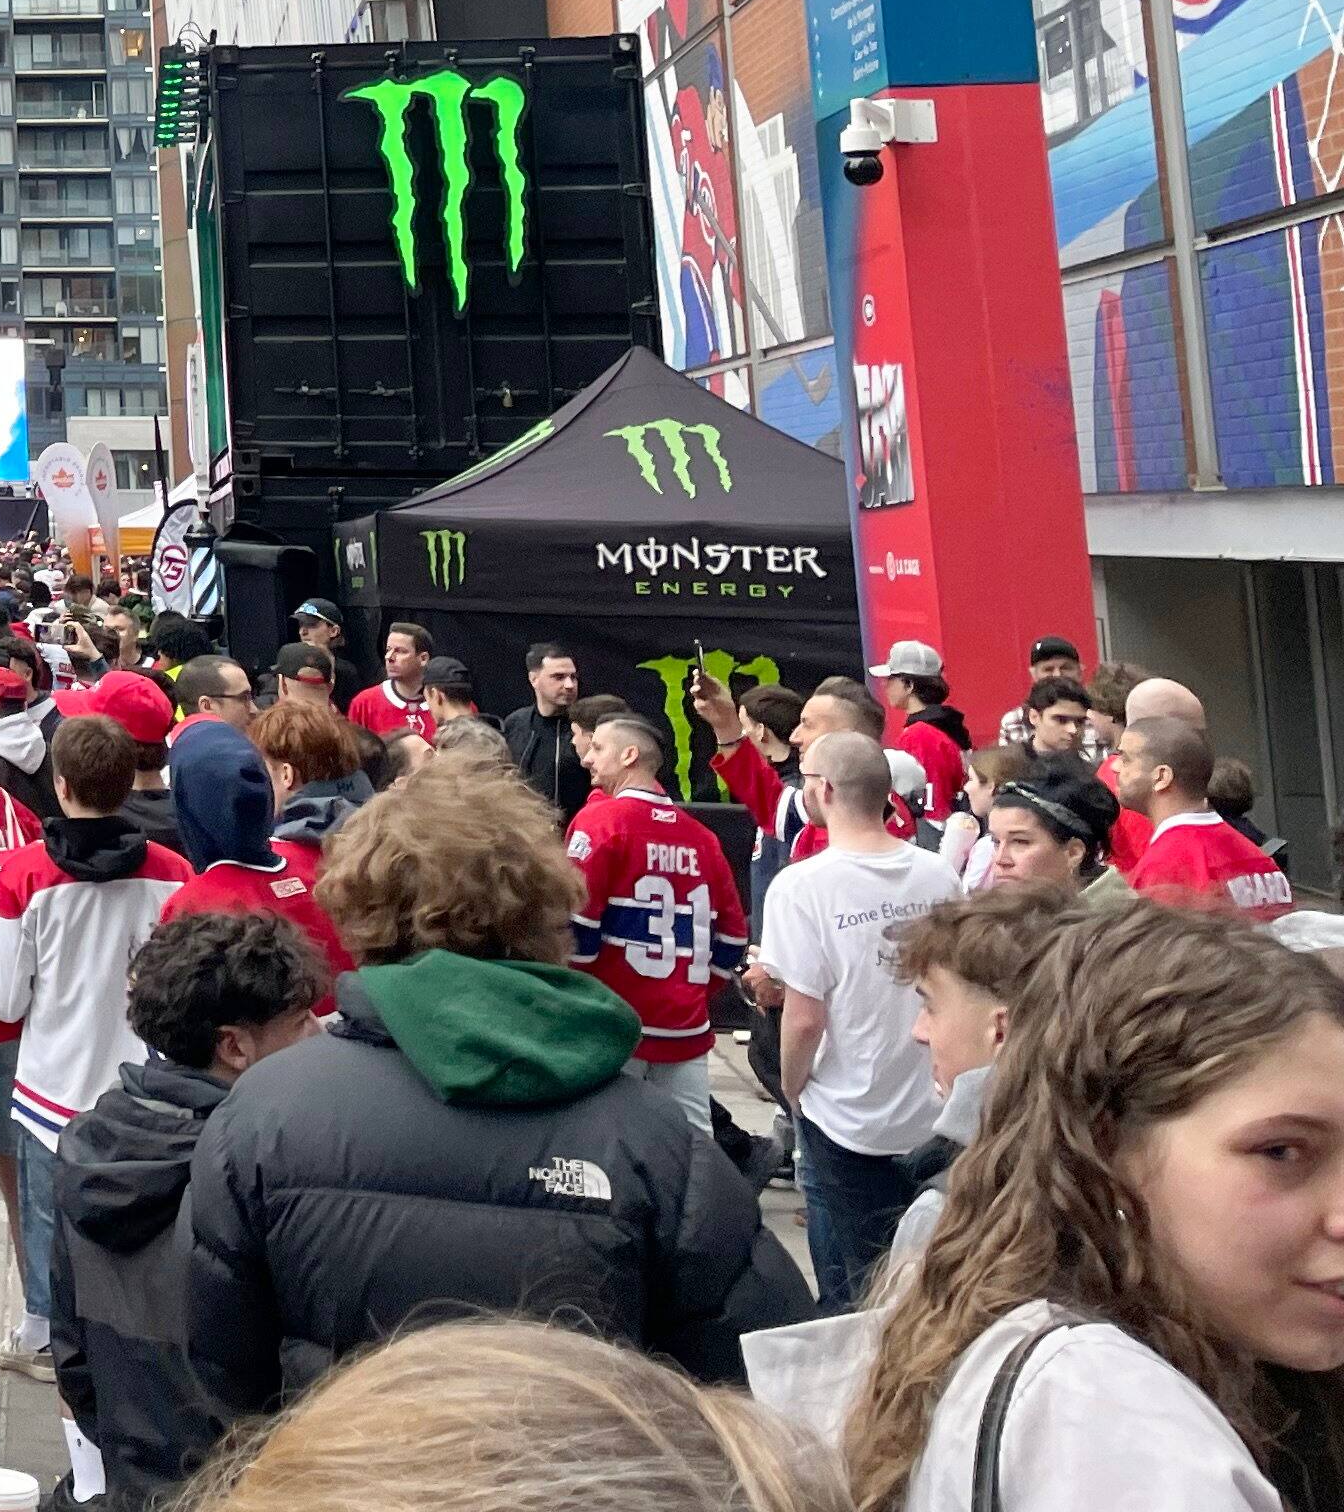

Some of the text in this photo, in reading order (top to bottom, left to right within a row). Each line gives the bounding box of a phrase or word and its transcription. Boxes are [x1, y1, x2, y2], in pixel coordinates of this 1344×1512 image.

[635, 581, 796, 599] ENERGY
[645, 842, 702, 877] PRICE
[835, 909, 879, 930] Zone
[624, 875, 713, 985] 31
[552, 1156, 584, 1170] THE
[529, 1167, 585, 1185] NORTH
[545, 1179, 585, 1197] FACE
